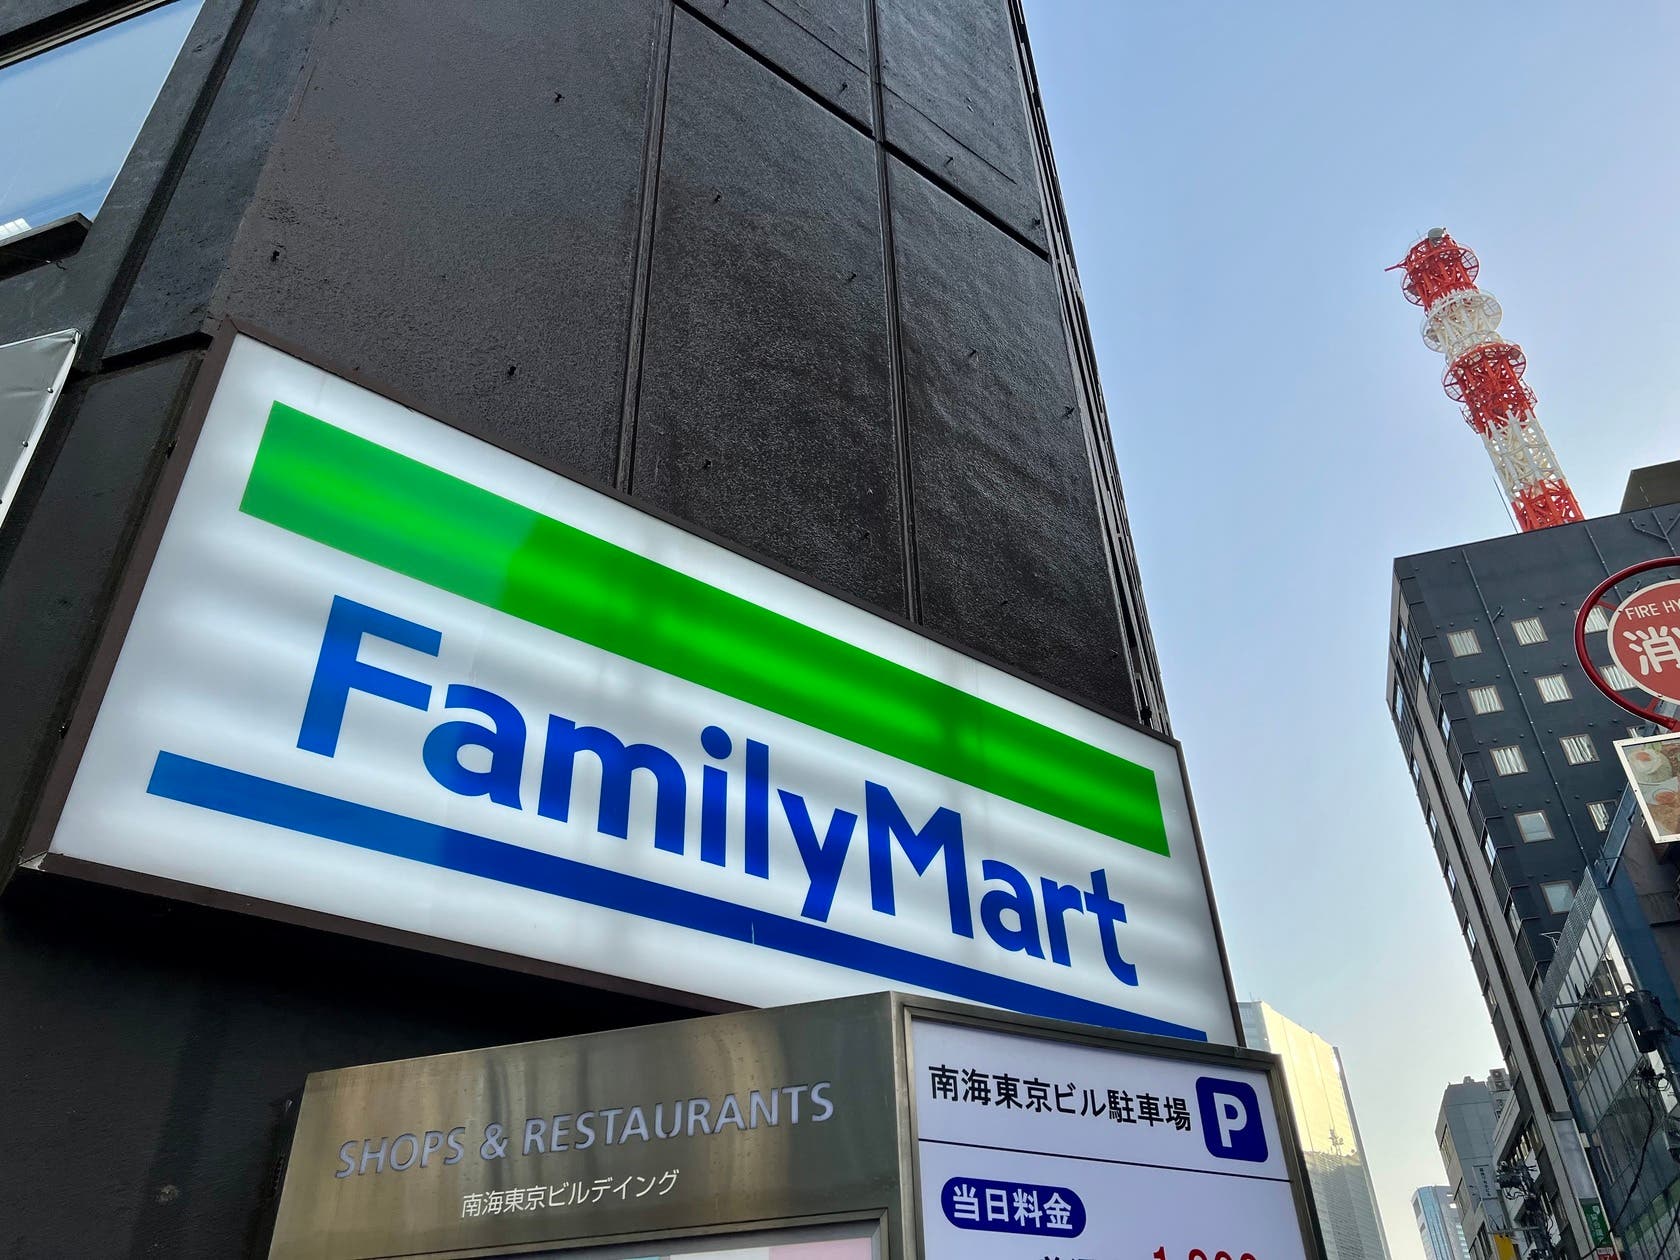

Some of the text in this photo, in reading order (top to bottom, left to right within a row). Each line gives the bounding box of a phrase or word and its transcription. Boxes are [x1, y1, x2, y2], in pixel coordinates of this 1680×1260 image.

[1625, 603, 1661, 620] FIRE
[297, 595, 1138, 987] FamilyMart
[335, 1081, 834, 1179] SHOPS & RESTAURANTS
[928, 1064, 1248, 1149] 南海東京ビル駐車場 P
[952, 1183, 1073, 1231] 当日料金
